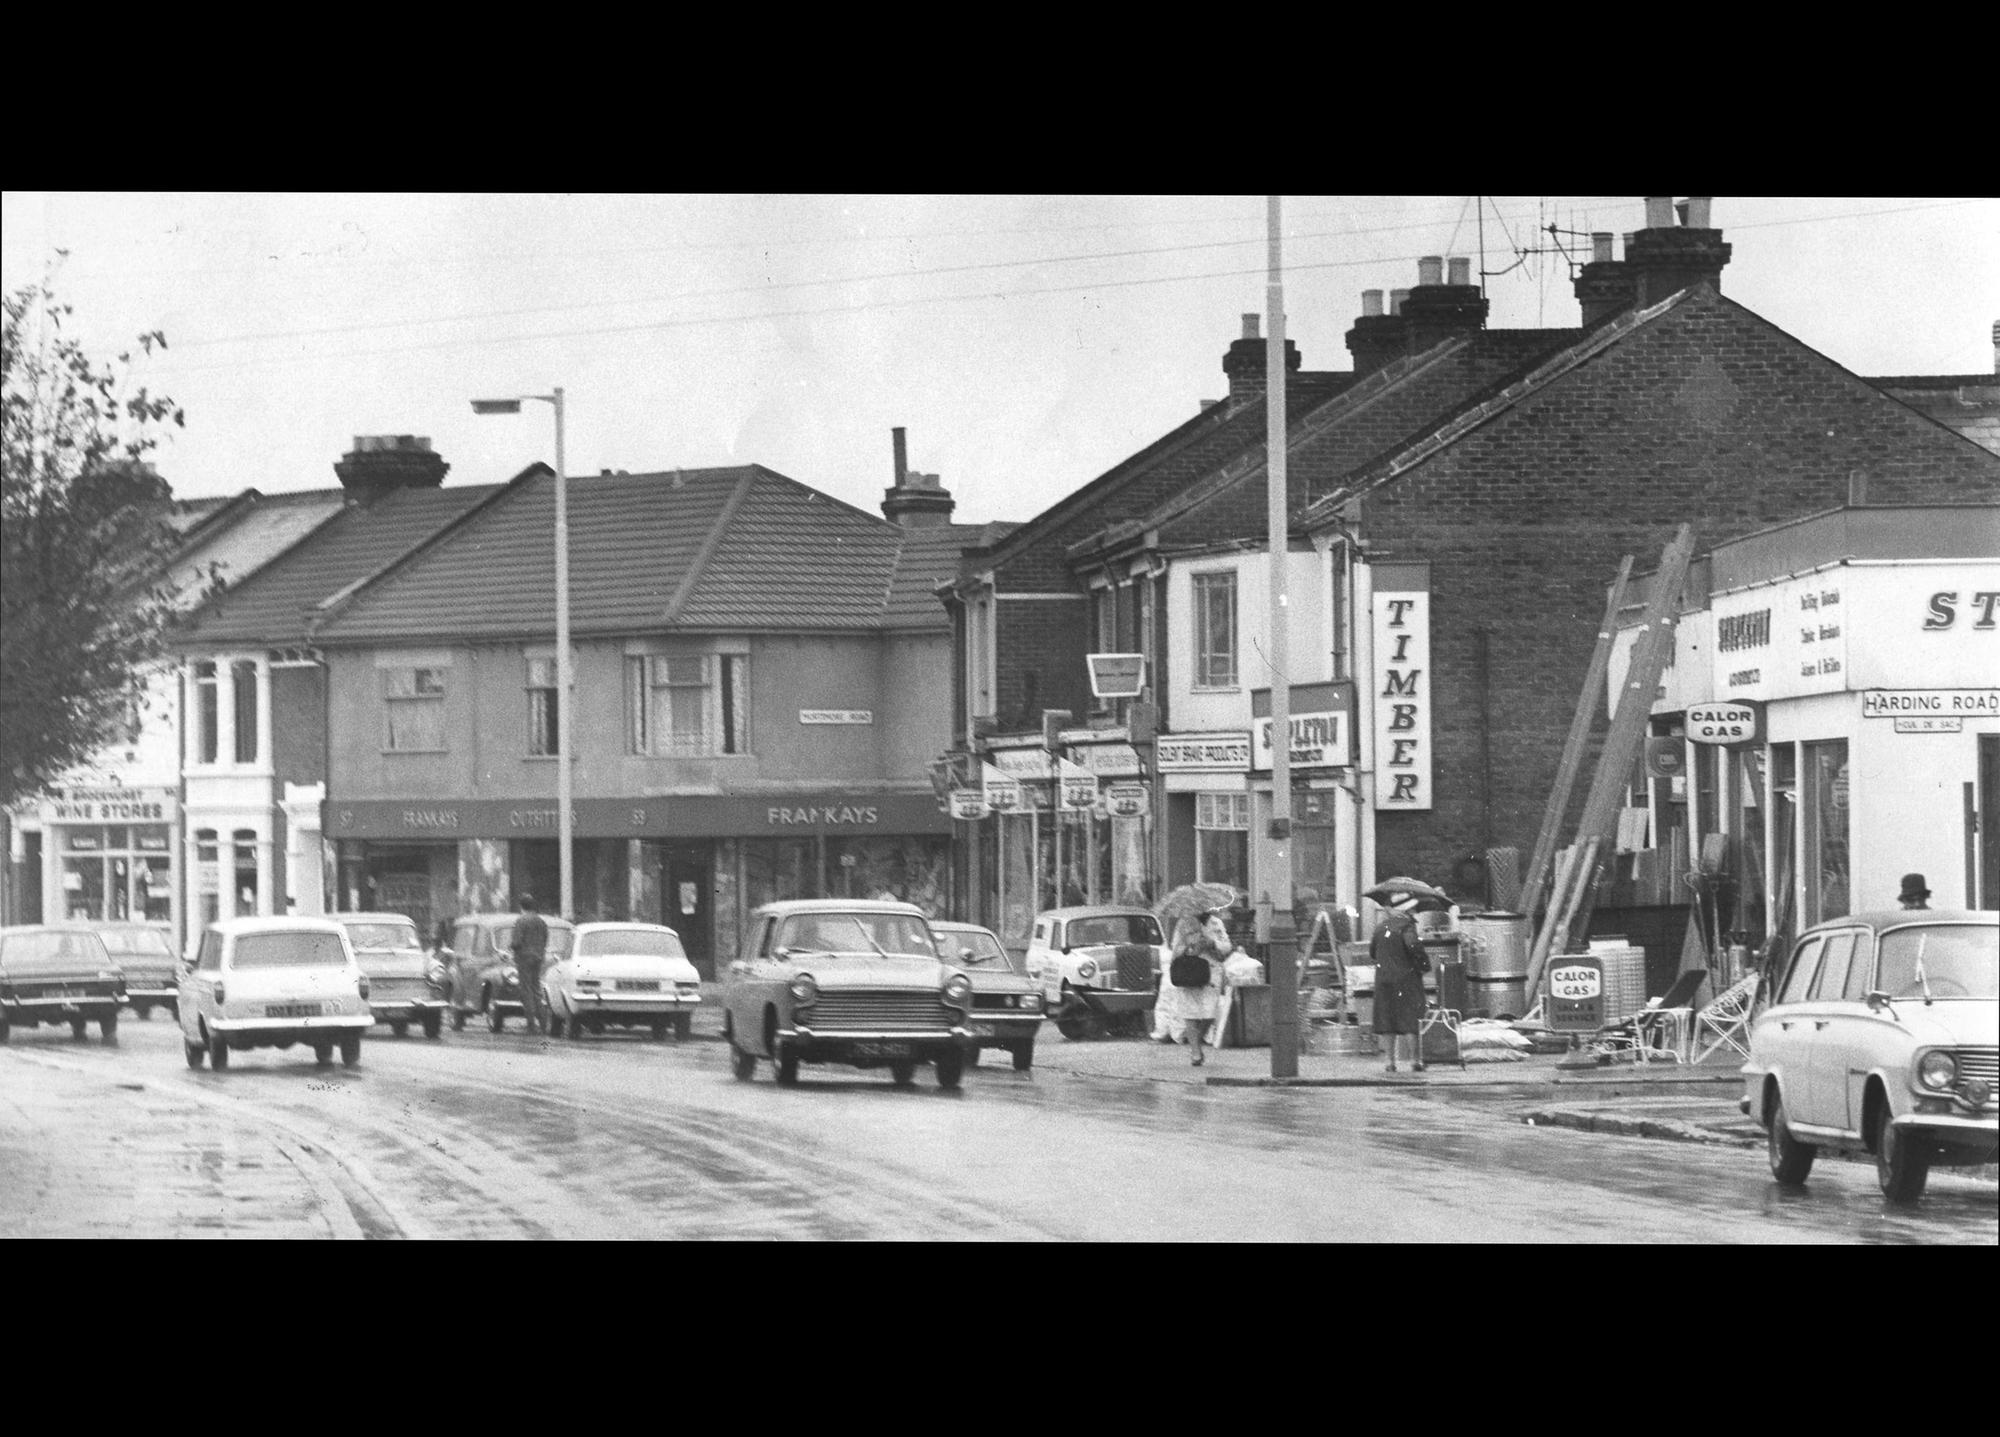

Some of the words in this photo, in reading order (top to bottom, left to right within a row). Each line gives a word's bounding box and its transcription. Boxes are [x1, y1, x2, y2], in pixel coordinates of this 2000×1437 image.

[1922, 592, 1999, 631] ST
[1380, 600, 1422, 802] TIMBER
[1865, 695, 1941, 711] HARDING
[1952, 695, 1998, 710] ROAD
[1690, 711, 1752, 722] CALOR
[1262, 716, 1338, 750] SPLETON
[1702, 726, 1742, 737] GAS
[55, 803, 92, 819] WINE
[101, 803, 162, 819] STORES
[1554, 971, 1596, 982] CALOR
[1563, 985, 1589, 995] GAS
